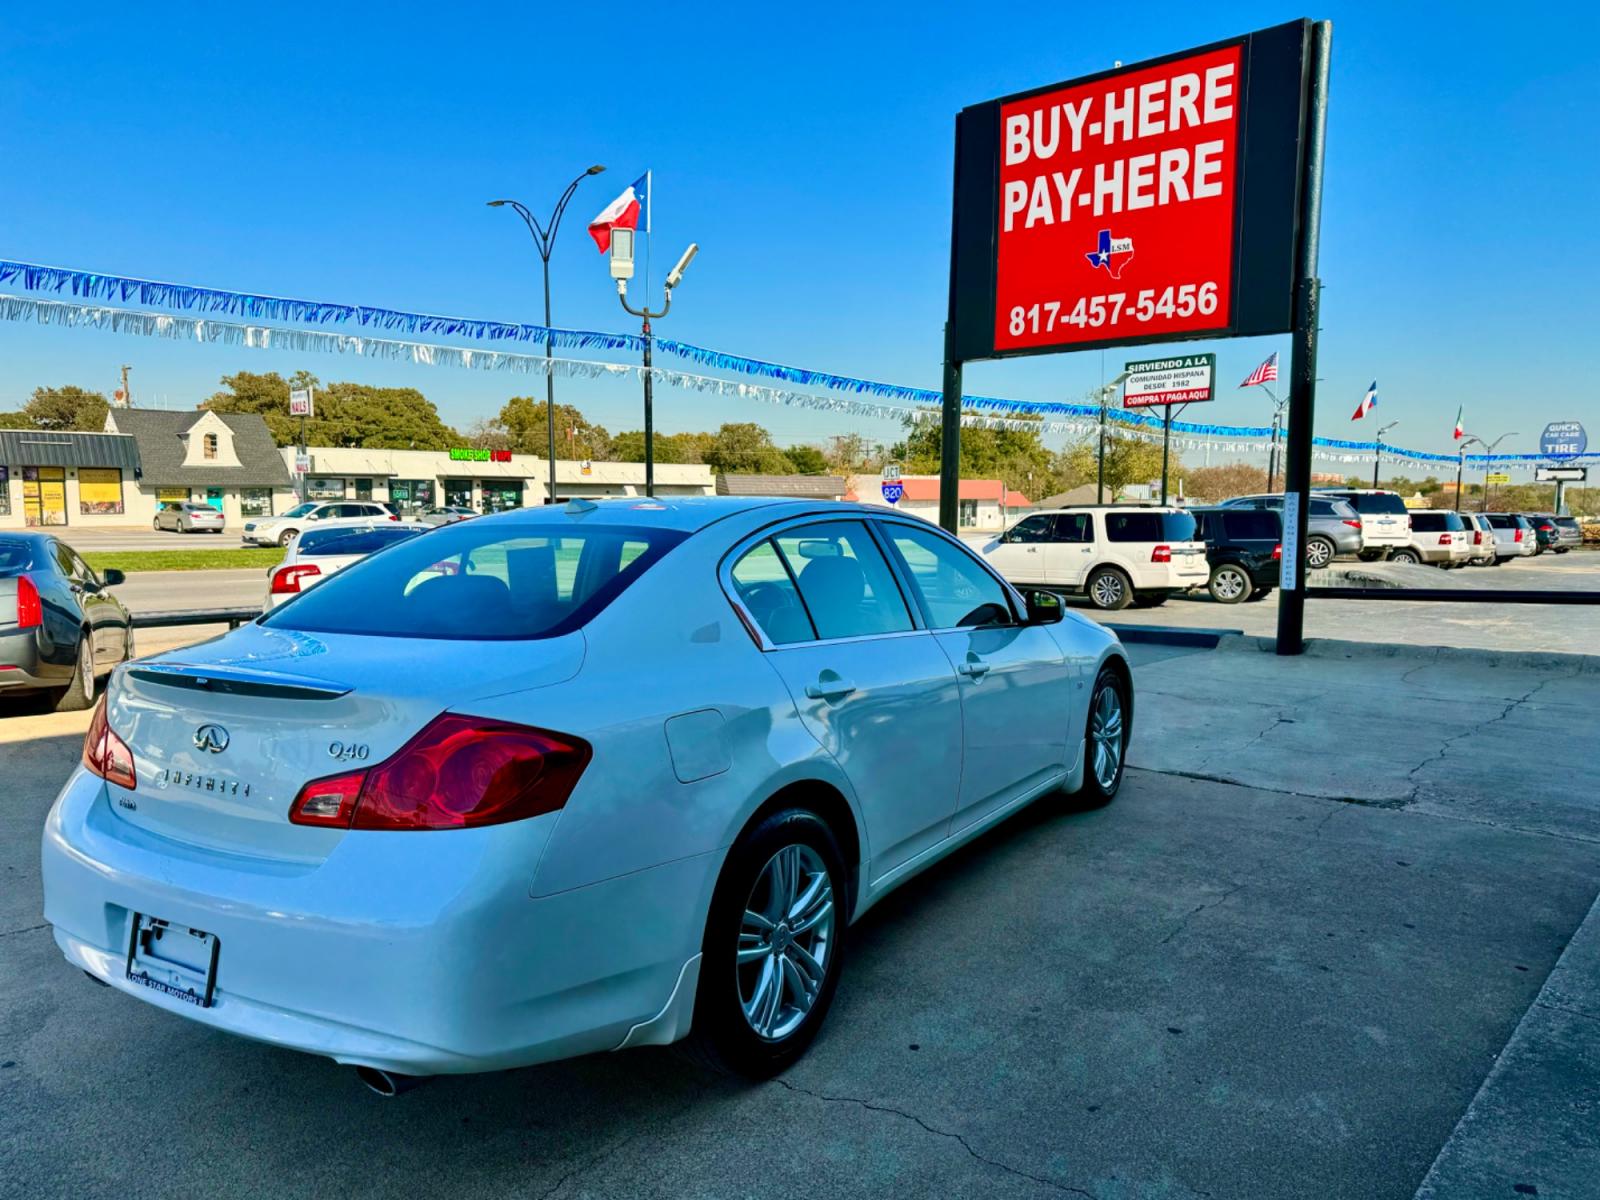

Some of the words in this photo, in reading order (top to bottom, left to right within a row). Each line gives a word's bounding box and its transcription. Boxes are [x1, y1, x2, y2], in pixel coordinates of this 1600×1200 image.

[1005, 62, 1235, 167] BUY-HERE
[1003, 139, 1225, 233] PAY-HERE
[1111, 243, 1131, 252] LSM
[1008, 281, 1219, 337] 817-457-5456
[1128, 359, 1183, 372] SIRVIENDO
[1184, 358, 1192, 366] A
[1194, 356, 1208, 365] LA
[1130, 373, 1172, 383] COMUNIDAD
[1173, 370, 1205, 379] HISPANA
[1143, 382, 1166, 390] DESDE
[1127, 395, 1160, 405] COMPRA
[1160, 393, 1166, 402] Y
[1166, 391, 1188, 402] PAGA
[1549, 424, 1579, 432] QUICK
[450, 448, 473, 461] SMOKE
[473, 448, 490, 462] SHOP
[1545, 444, 1578, 453] TIRE
[885, 467, 899, 478] JCT
[884, 487, 901, 499] 820
[328, 740, 370, 762] Q40
[164, 768, 250, 798] INFINITI
[128, 974, 147, 986] LONE
[148, 980, 166, 993] STAR
[167, 986, 197, 1004] MOTORS
